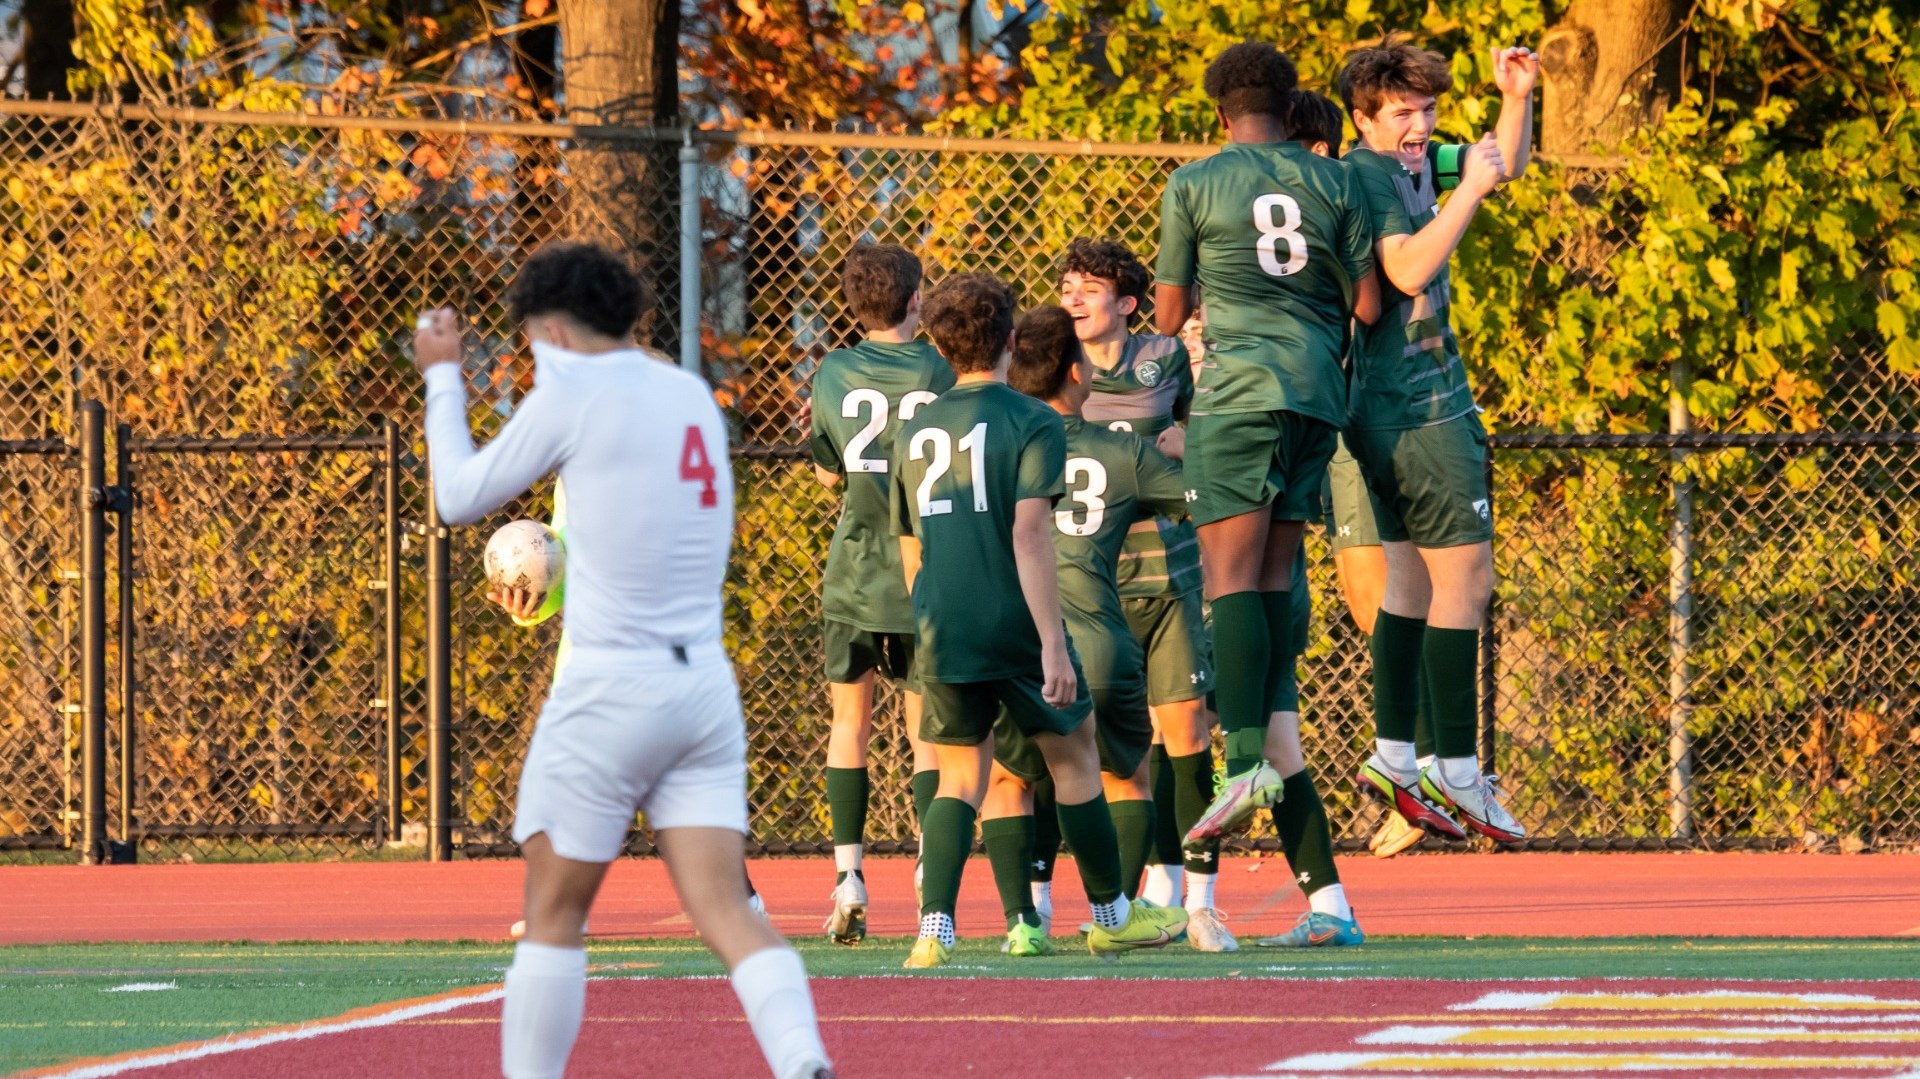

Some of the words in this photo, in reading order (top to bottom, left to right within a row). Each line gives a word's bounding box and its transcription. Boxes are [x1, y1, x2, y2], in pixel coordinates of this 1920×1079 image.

[1252, 193, 1309, 276] 8
[679, 425, 718, 509] 4
[909, 422, 988, 517] 21
[1055, 457, 1107, 536] 3
